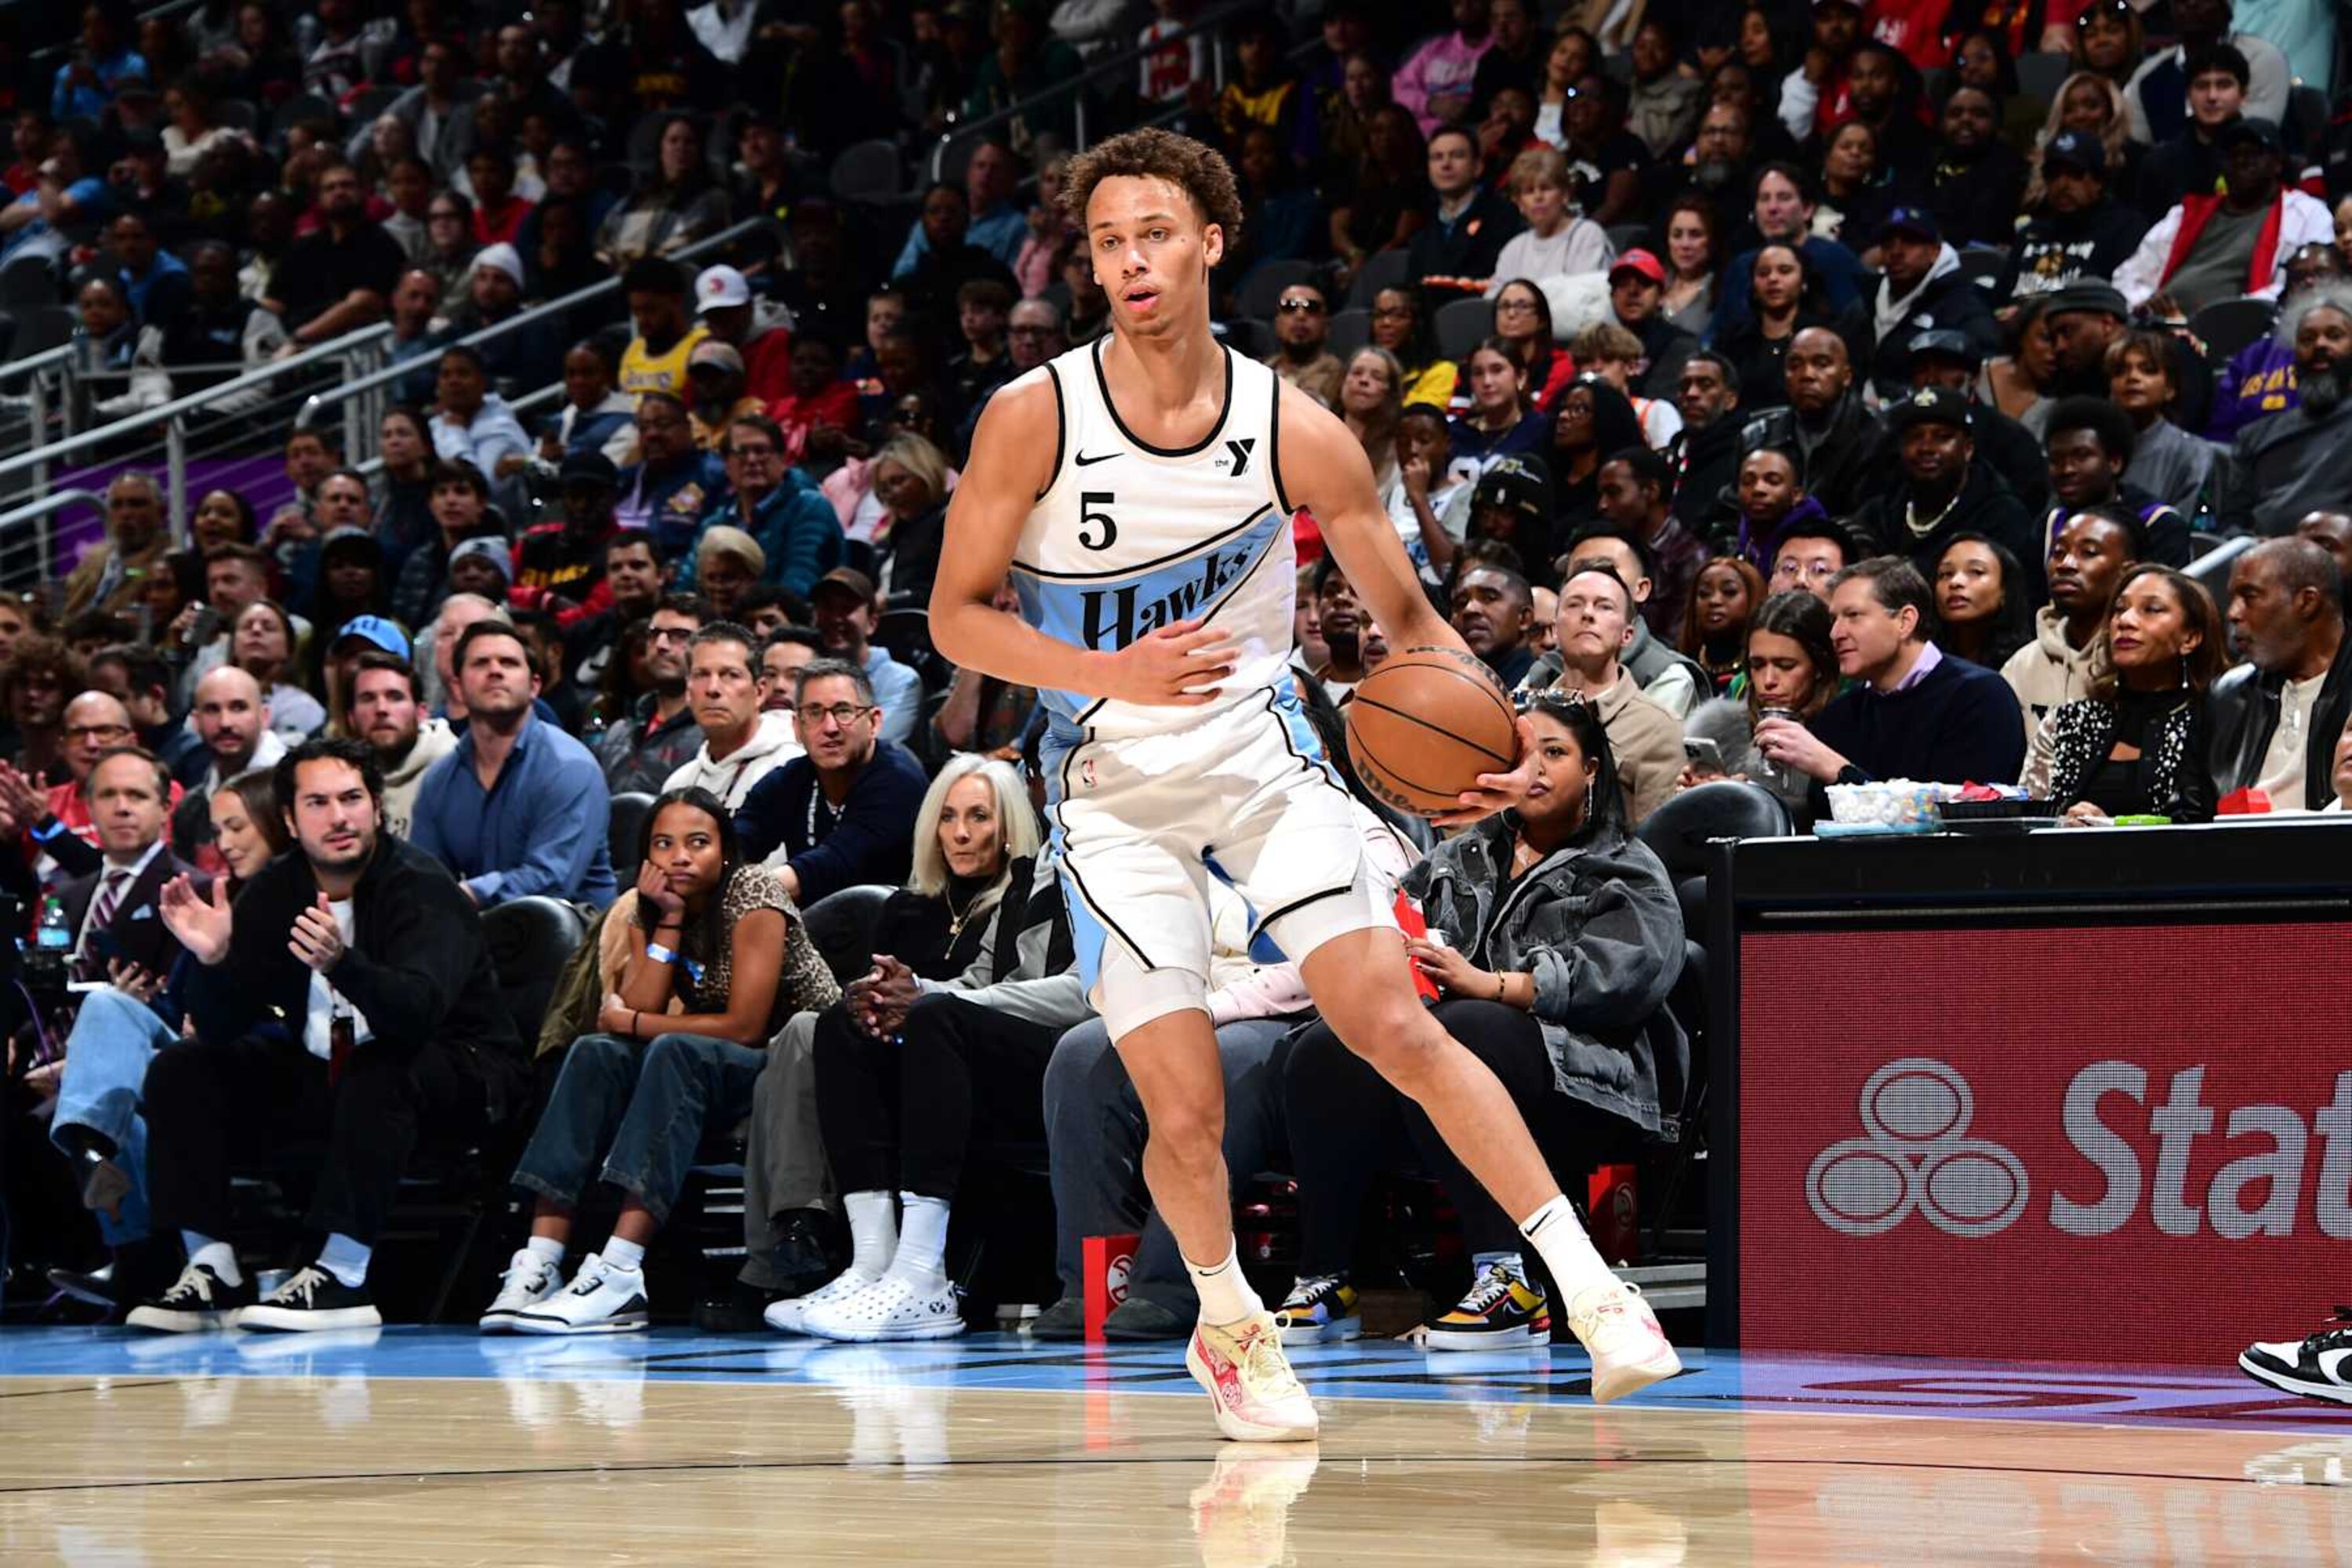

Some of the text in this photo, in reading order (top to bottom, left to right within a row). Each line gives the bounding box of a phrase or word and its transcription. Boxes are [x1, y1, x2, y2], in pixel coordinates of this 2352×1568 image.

[1214, 459, 1229, 468] the
[1078, 492, 1117, 551] 5
[1080, 543, 1254, 652] Hawks
